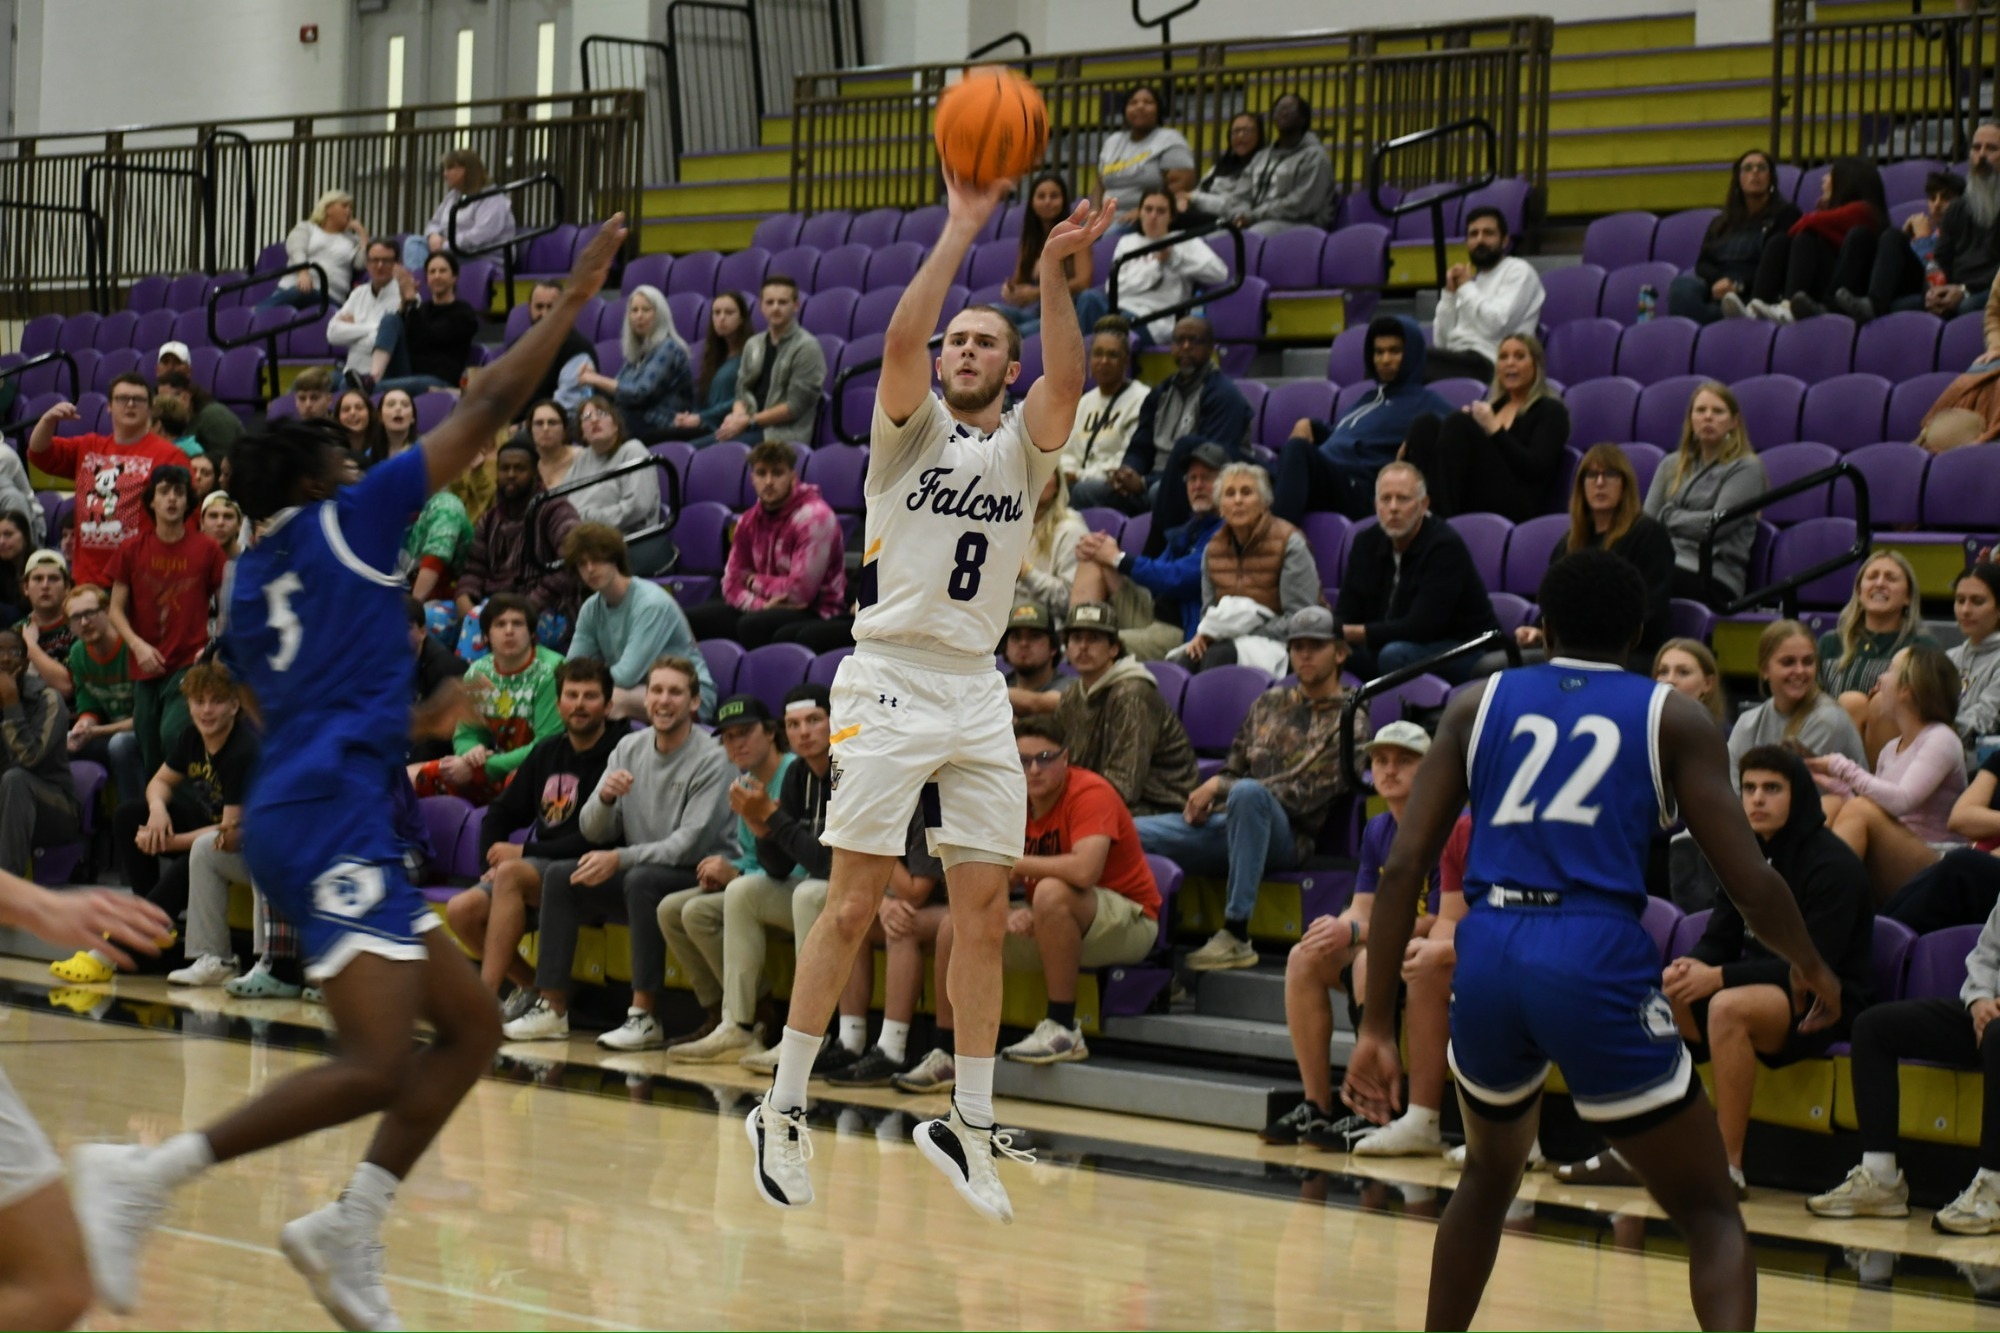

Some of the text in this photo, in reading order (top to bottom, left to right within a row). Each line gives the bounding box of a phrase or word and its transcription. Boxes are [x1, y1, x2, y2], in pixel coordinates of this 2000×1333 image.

[907, 467, 1023, 523] Falcons
[948, 531, 989, 601] 8
[261, 571, 304, 671] 5
[1490, 713, 1621, 828] 22
